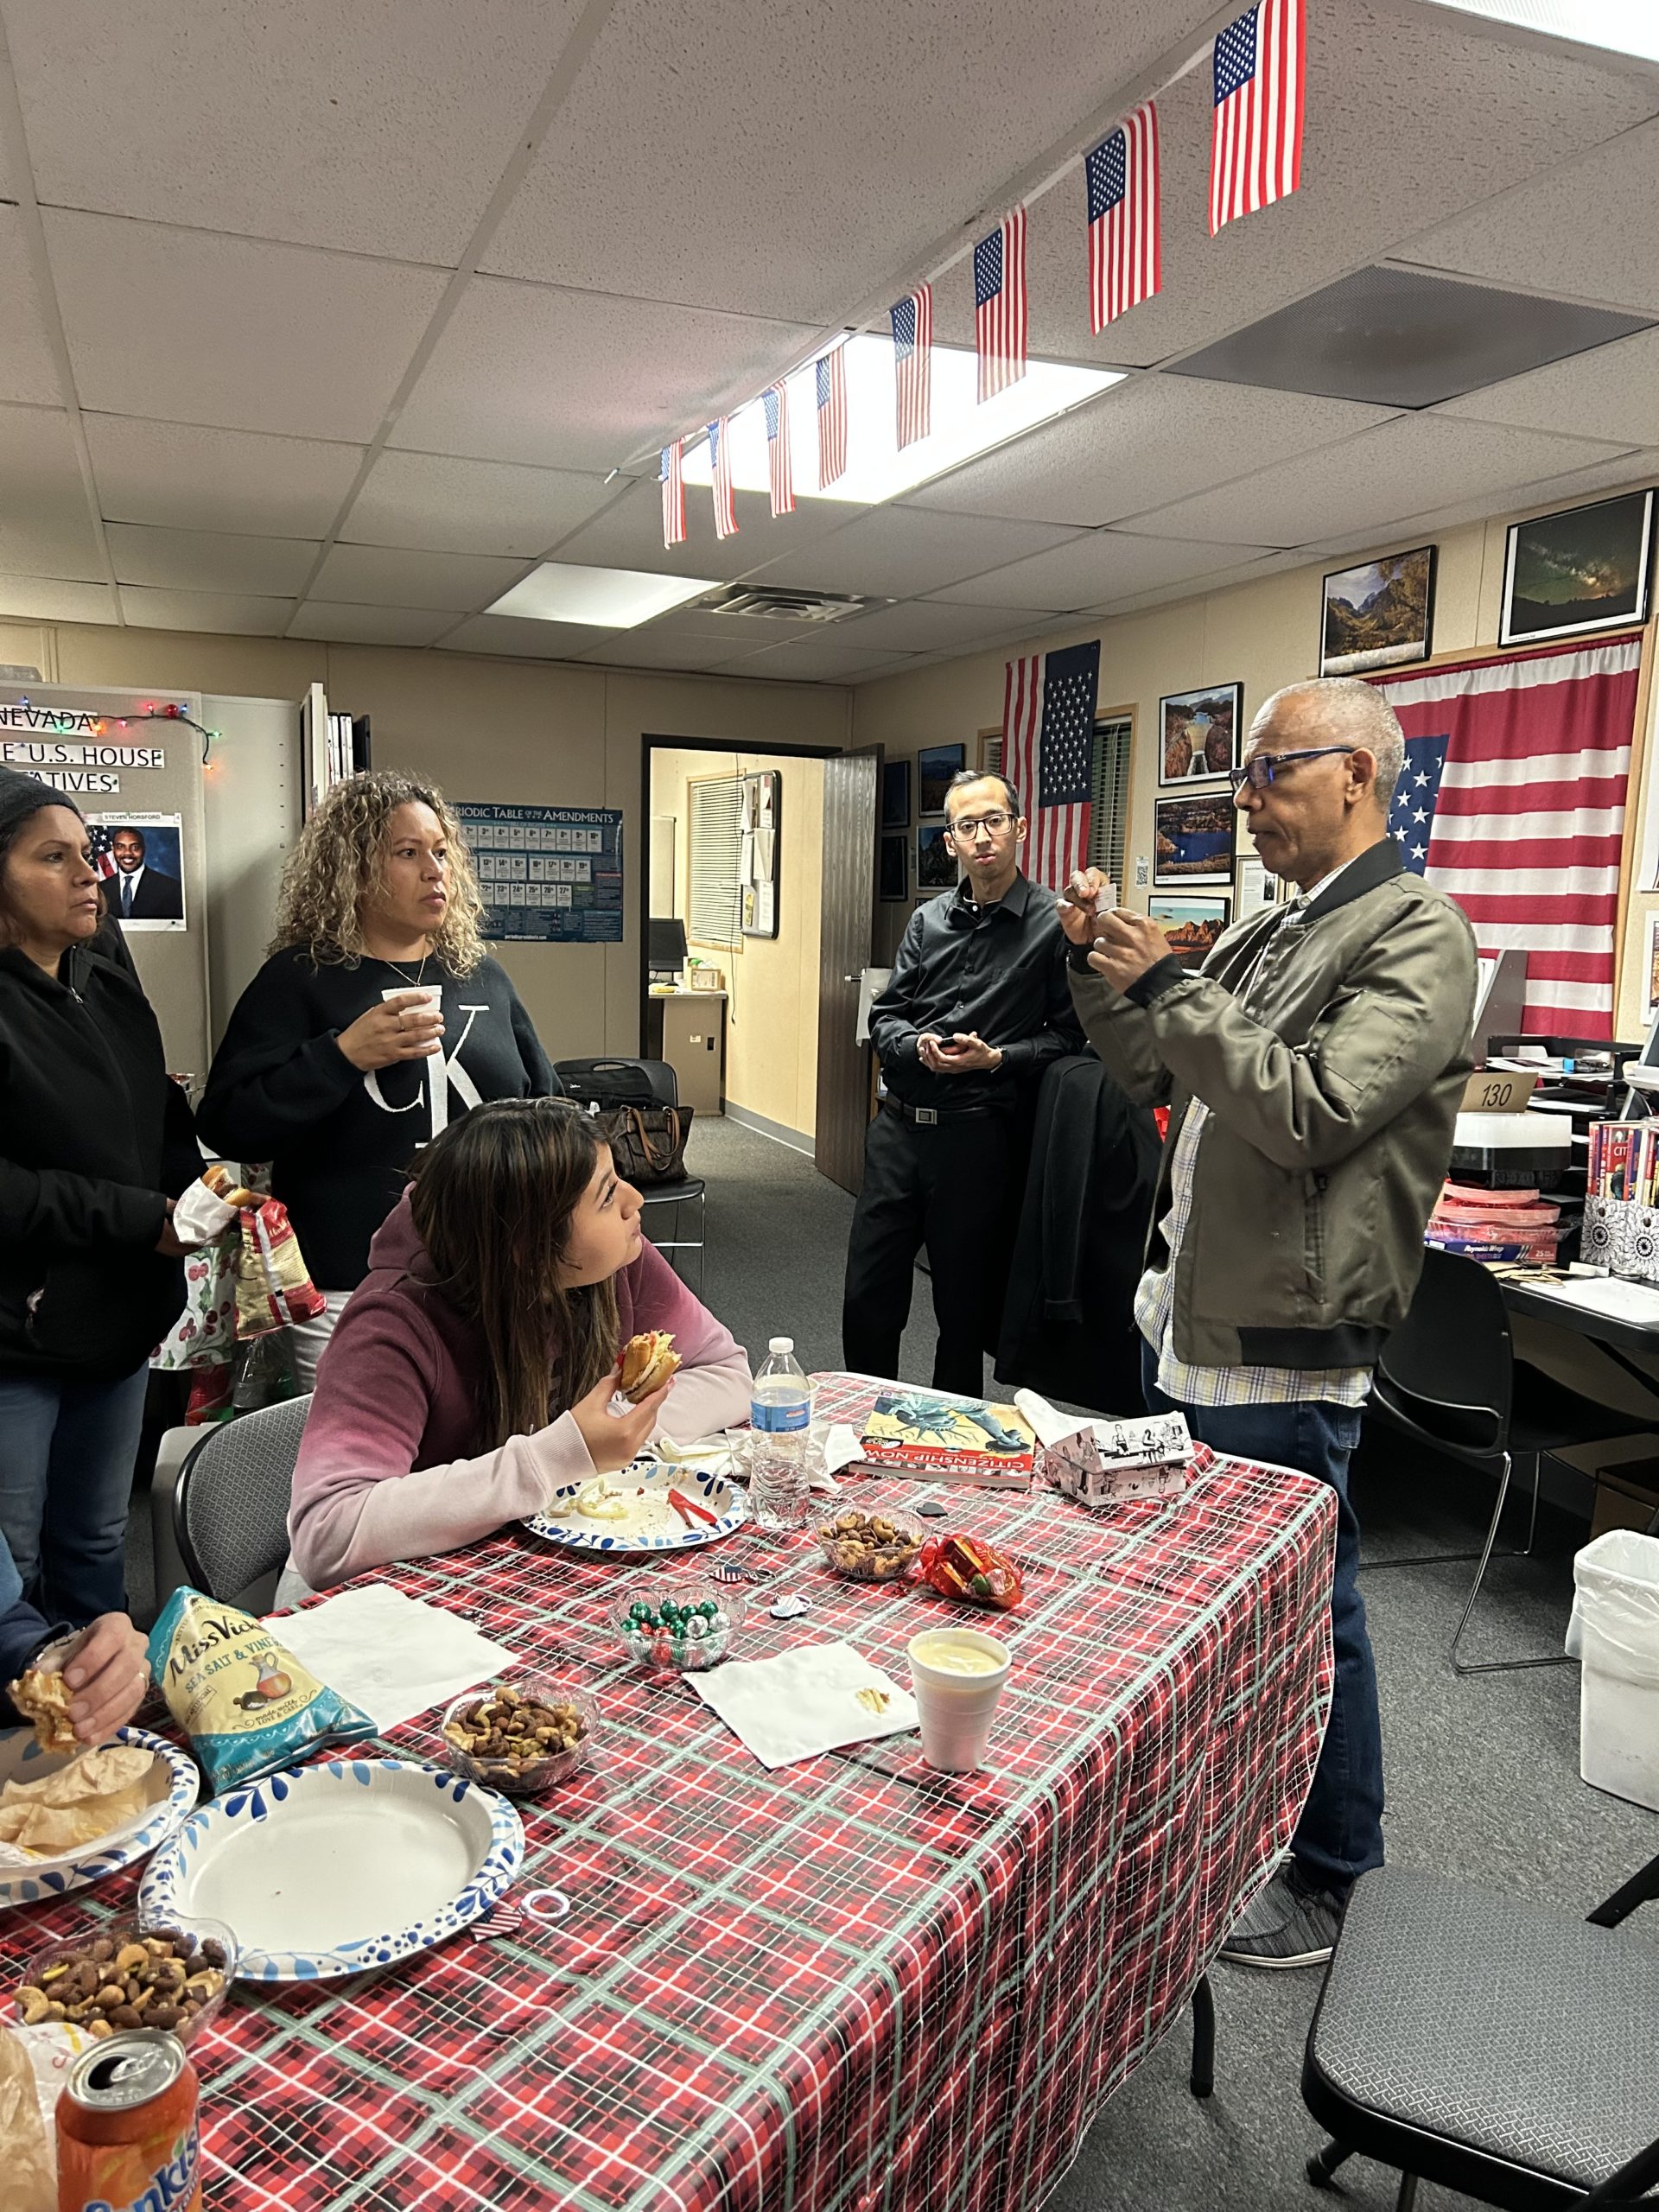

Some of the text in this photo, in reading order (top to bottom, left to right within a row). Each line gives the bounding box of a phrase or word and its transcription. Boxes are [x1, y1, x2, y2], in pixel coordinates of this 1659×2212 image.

[0, 708, 92, 732] NEVADA
[29, 744, 73, 762] U.S.
[82, 747, 162, 767] HOUSE
[22, 772, 112, 792] TIVES
[455, 806, 491, 818] RIODIC
[493, 807, 524, 819] TABLE
[543, 810, 613, 823] AMENDMENTS
[1482, 1084, 1512, 1107] 130
[865, 1449, 1024, 1468] CITIZENSHIP NOW
[170, 1616, 263, 1688] Miss Vick
[185, 1636, 283, 1694] SEA SALT & VINEG
[256, 1710, 276, 1721] made
[257, 1714, 276, 1726] LOVE
[84, 2129, 200, 2212] nkis
